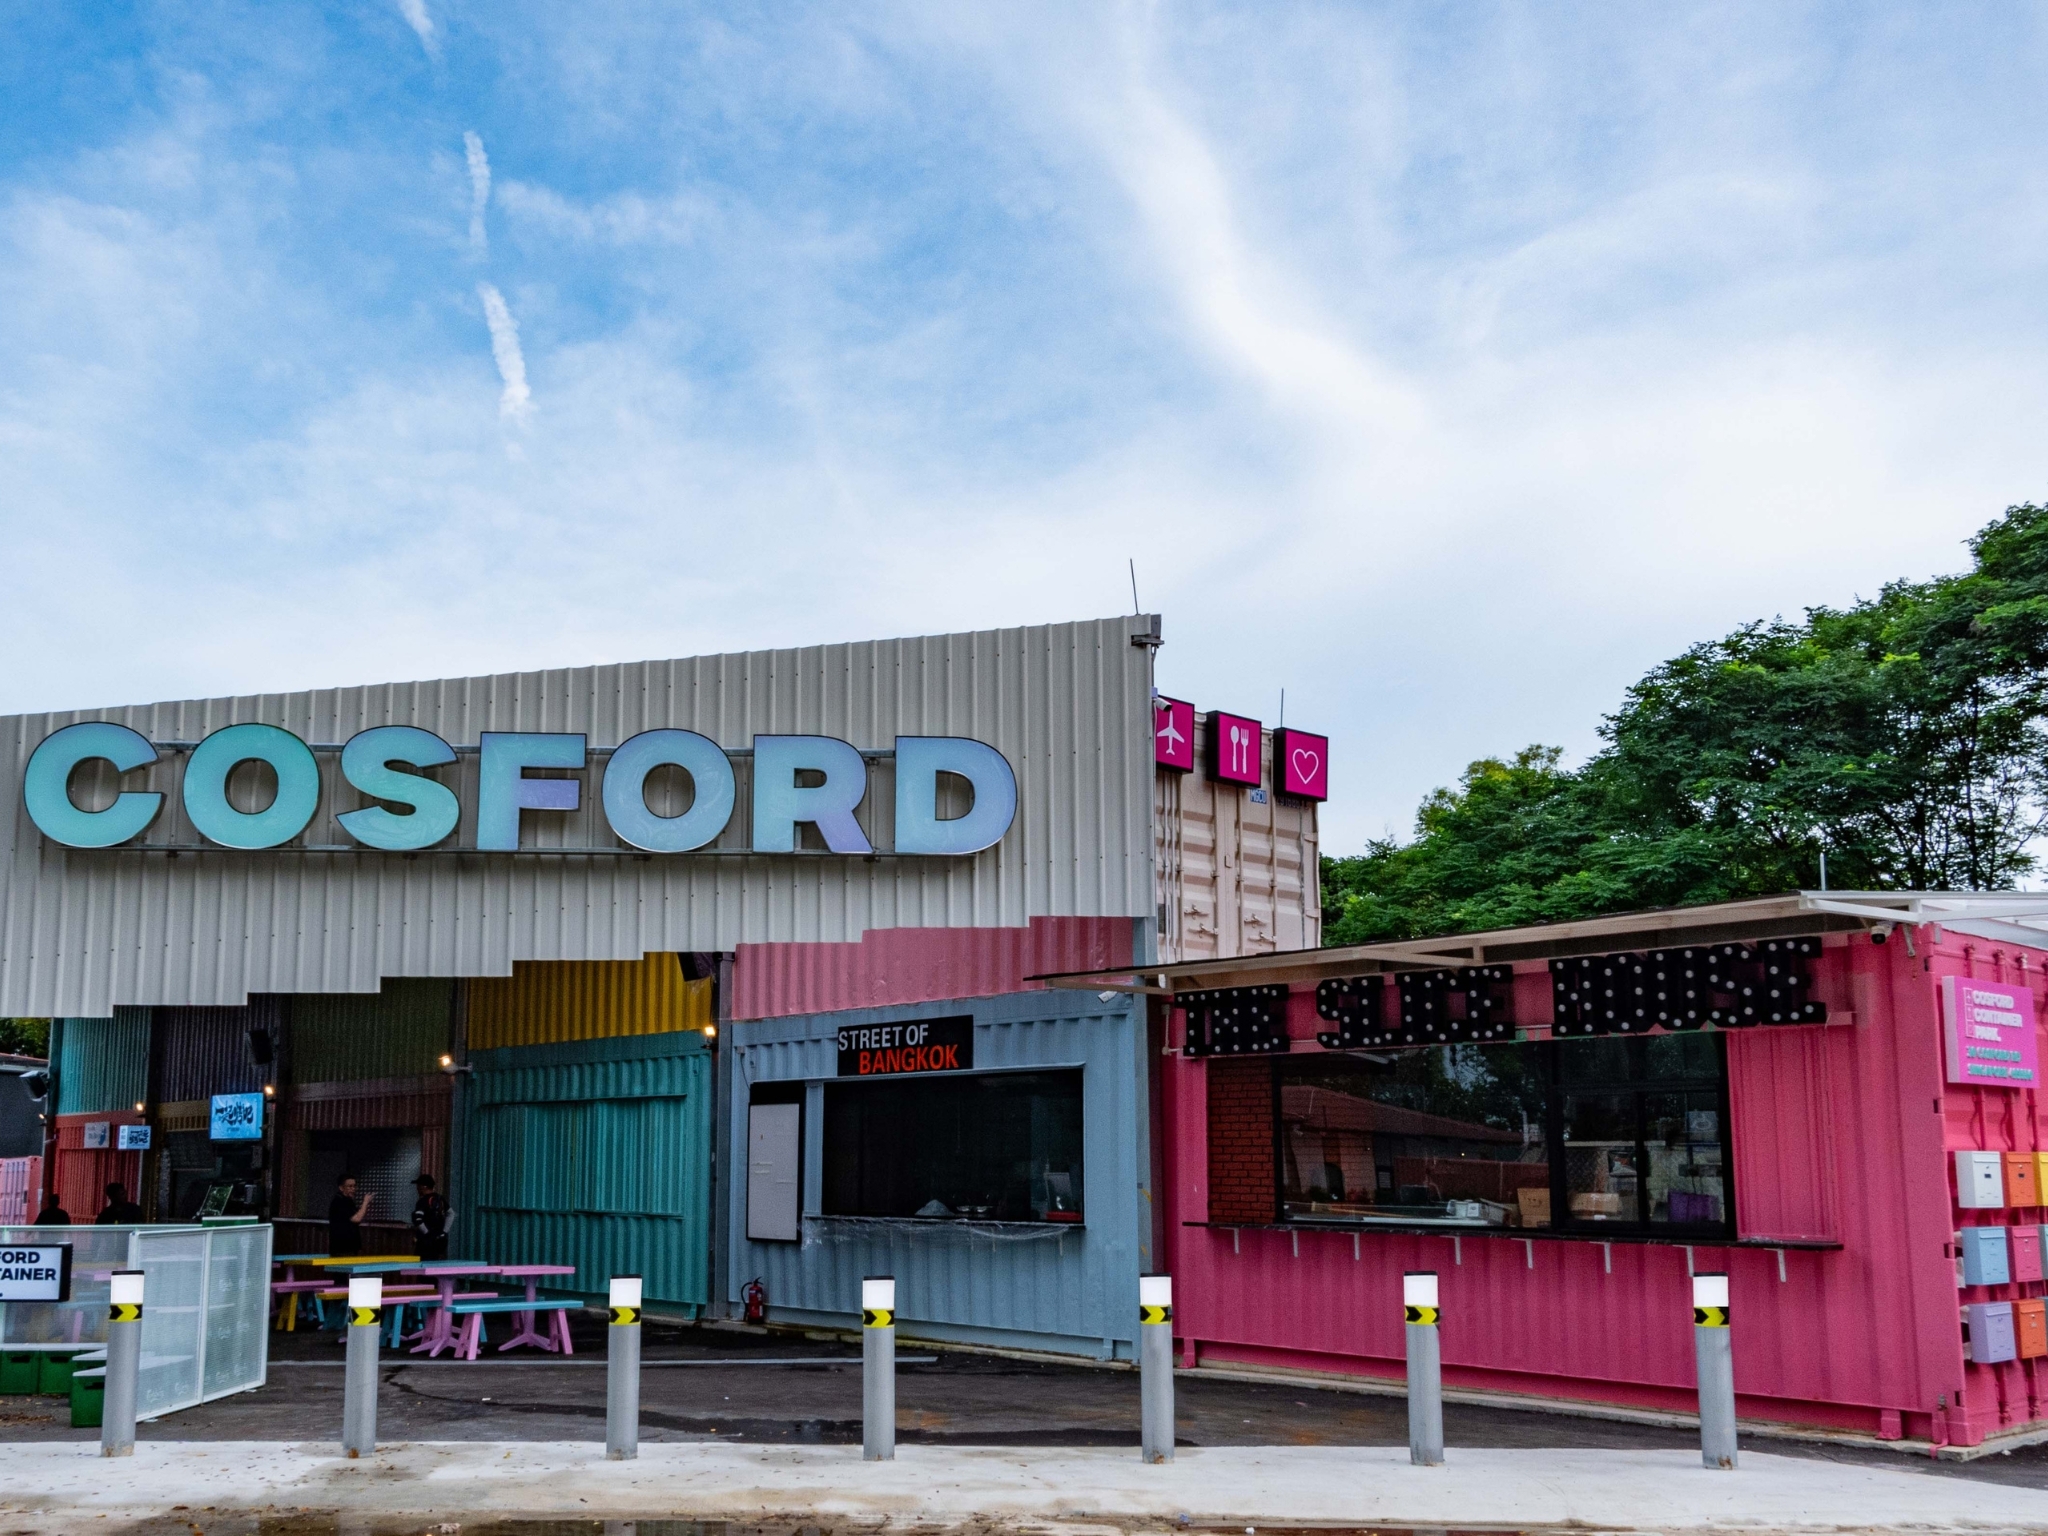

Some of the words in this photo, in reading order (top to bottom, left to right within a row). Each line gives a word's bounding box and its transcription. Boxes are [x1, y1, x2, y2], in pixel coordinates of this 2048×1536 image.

[24, 721, 1019, 856] COSFORD
[1175, 984, 1290, 1057] THE
[1316, 964, 1516, 1049] SLICE
[1549, 936, 1827, 1037] HOUSE
[838, 1026, 903, 1051] STREET
[905, 1024, 929, 1046] OF
[859, 1045, 959, 1074] BANGKOK
[0, 1251, 41, 1264] ORD
[0, 1267, 57, 1281] AINER
